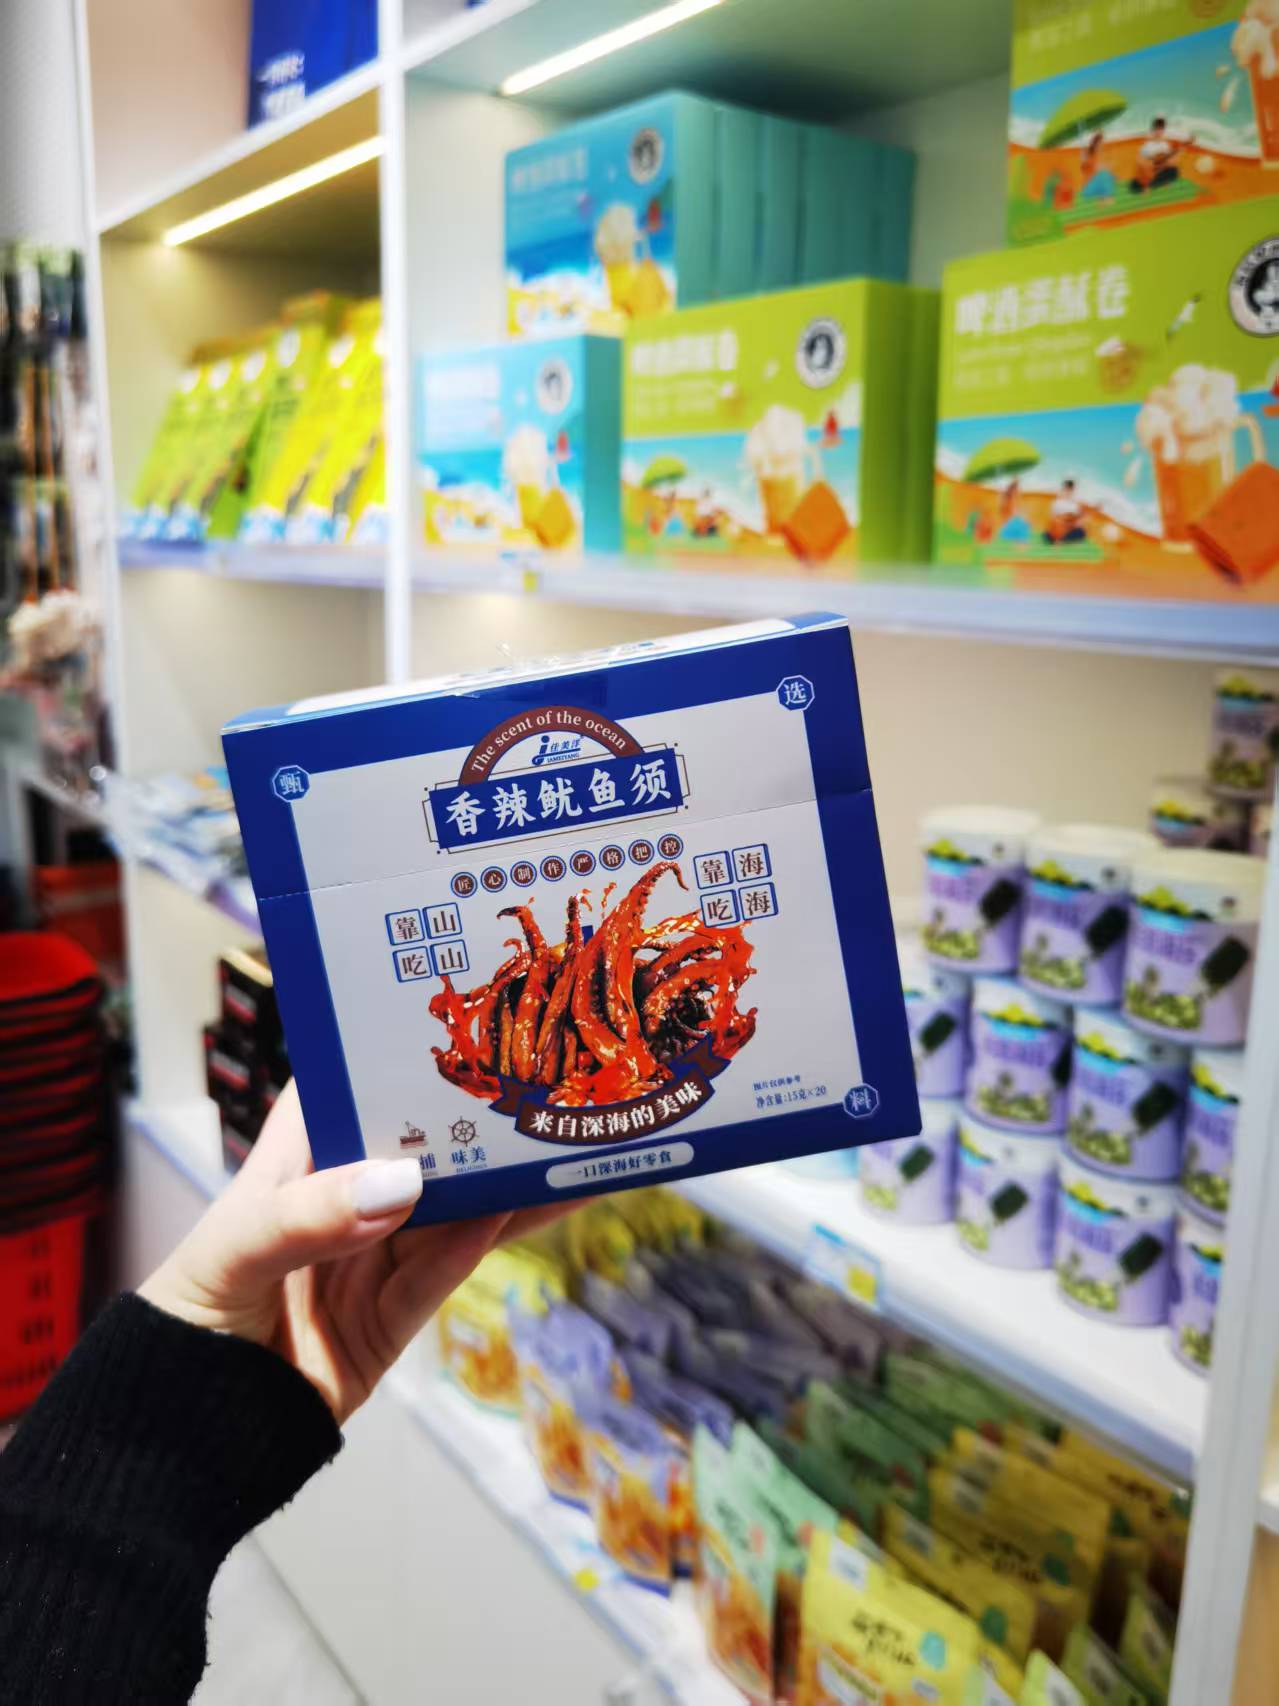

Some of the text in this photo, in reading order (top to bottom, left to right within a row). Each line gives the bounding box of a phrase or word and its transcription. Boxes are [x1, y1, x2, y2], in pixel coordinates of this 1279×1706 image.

[783, 681, 806, 706] 选
[471, 711, 627, 773] The scent of the ocean
[279, 770, 305, 796] 甄
[446, 759, 671, 836] 香辣鱿鱼须
[456, 838, 678, 894] 匠心制作严格把控
[702, 852, 764, 884] 靠海
[707, 891, 771, 920] 吃海
[396, 910, 456, 940] 靠山
[402, 947, 463, 975] 吃山
[529, 1081, 702, 1138] 来自深海的美味
[849, 1087, 871, 1112] 料
[451, 1146, 487, 1165] 味美
[576, 1150, 672, 1178] 一口深海好零食
